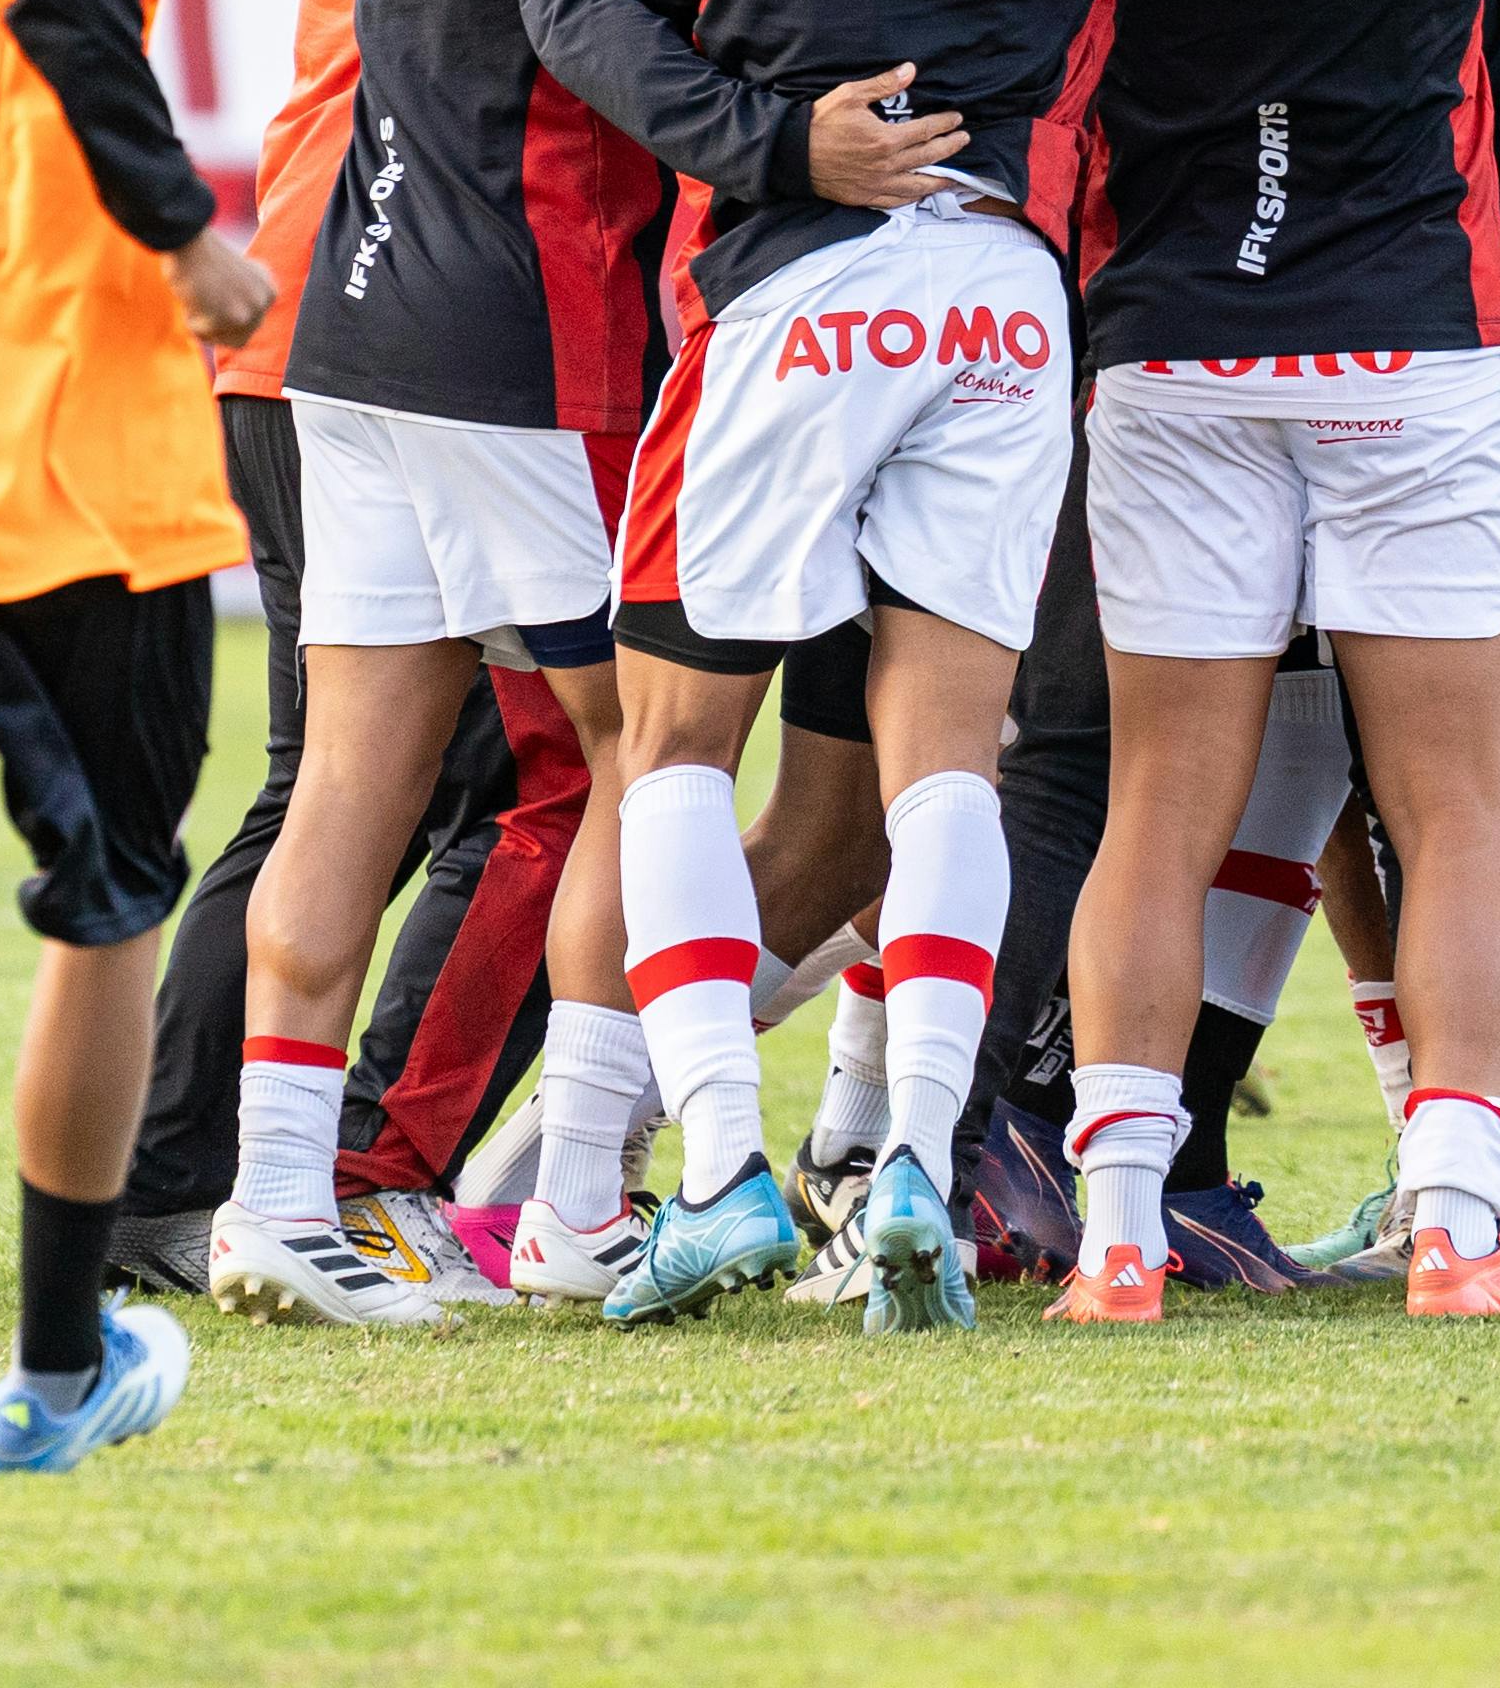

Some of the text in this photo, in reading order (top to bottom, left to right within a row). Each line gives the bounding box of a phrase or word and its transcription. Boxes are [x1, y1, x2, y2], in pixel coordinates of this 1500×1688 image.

[344, 116, 405, 300] IFK SORS
[1236, 102, 1289, 276] IFK SPORTS
[775, 305, 1052, 383] ATOMO
